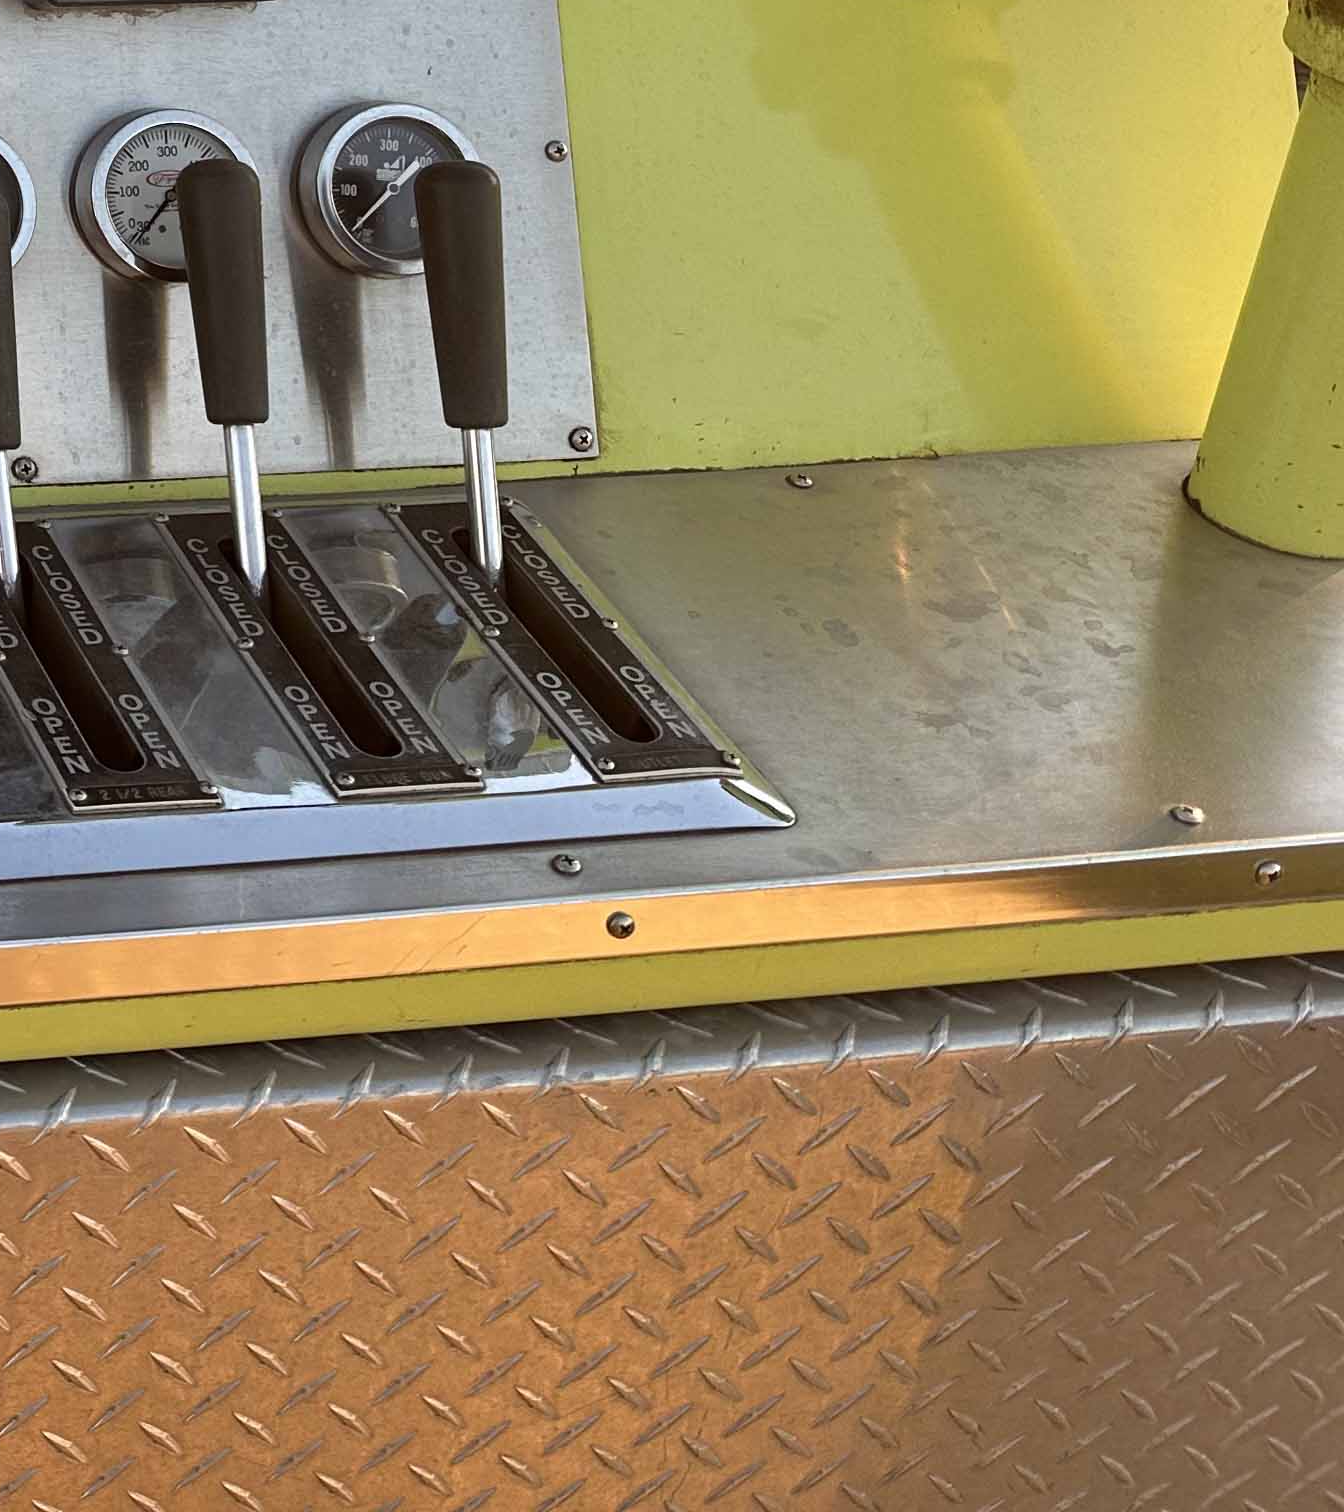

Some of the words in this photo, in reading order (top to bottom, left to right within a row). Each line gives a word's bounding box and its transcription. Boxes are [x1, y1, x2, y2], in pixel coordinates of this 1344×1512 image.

[128, 160, 150, 172] 200
[157, 145, 178, 157] 300
[349, 154, 369, 167] 200
[379, 139, 399, 152] 300
[119, 185, 140, 198] 100
[340, 183, 358, 197] 100
[31, 545, 103, 646] CLOSED
[187, 538, 265, 637] CLOSED
[266, 535, 348, 633] CLOSED
[421, 528, 509, 626] CLOSED
[502, 524, 590, 620] CLOSED
[31, 698, 90, 774] OPEN
[118, 694, 181, 769] OPEN
[284, 685, 352, 760] OPEN
[369, 680, 440, 755] OPEN
[536, 671, 611, 745] OPEN
[619, 665, 697, 739] OPEN
